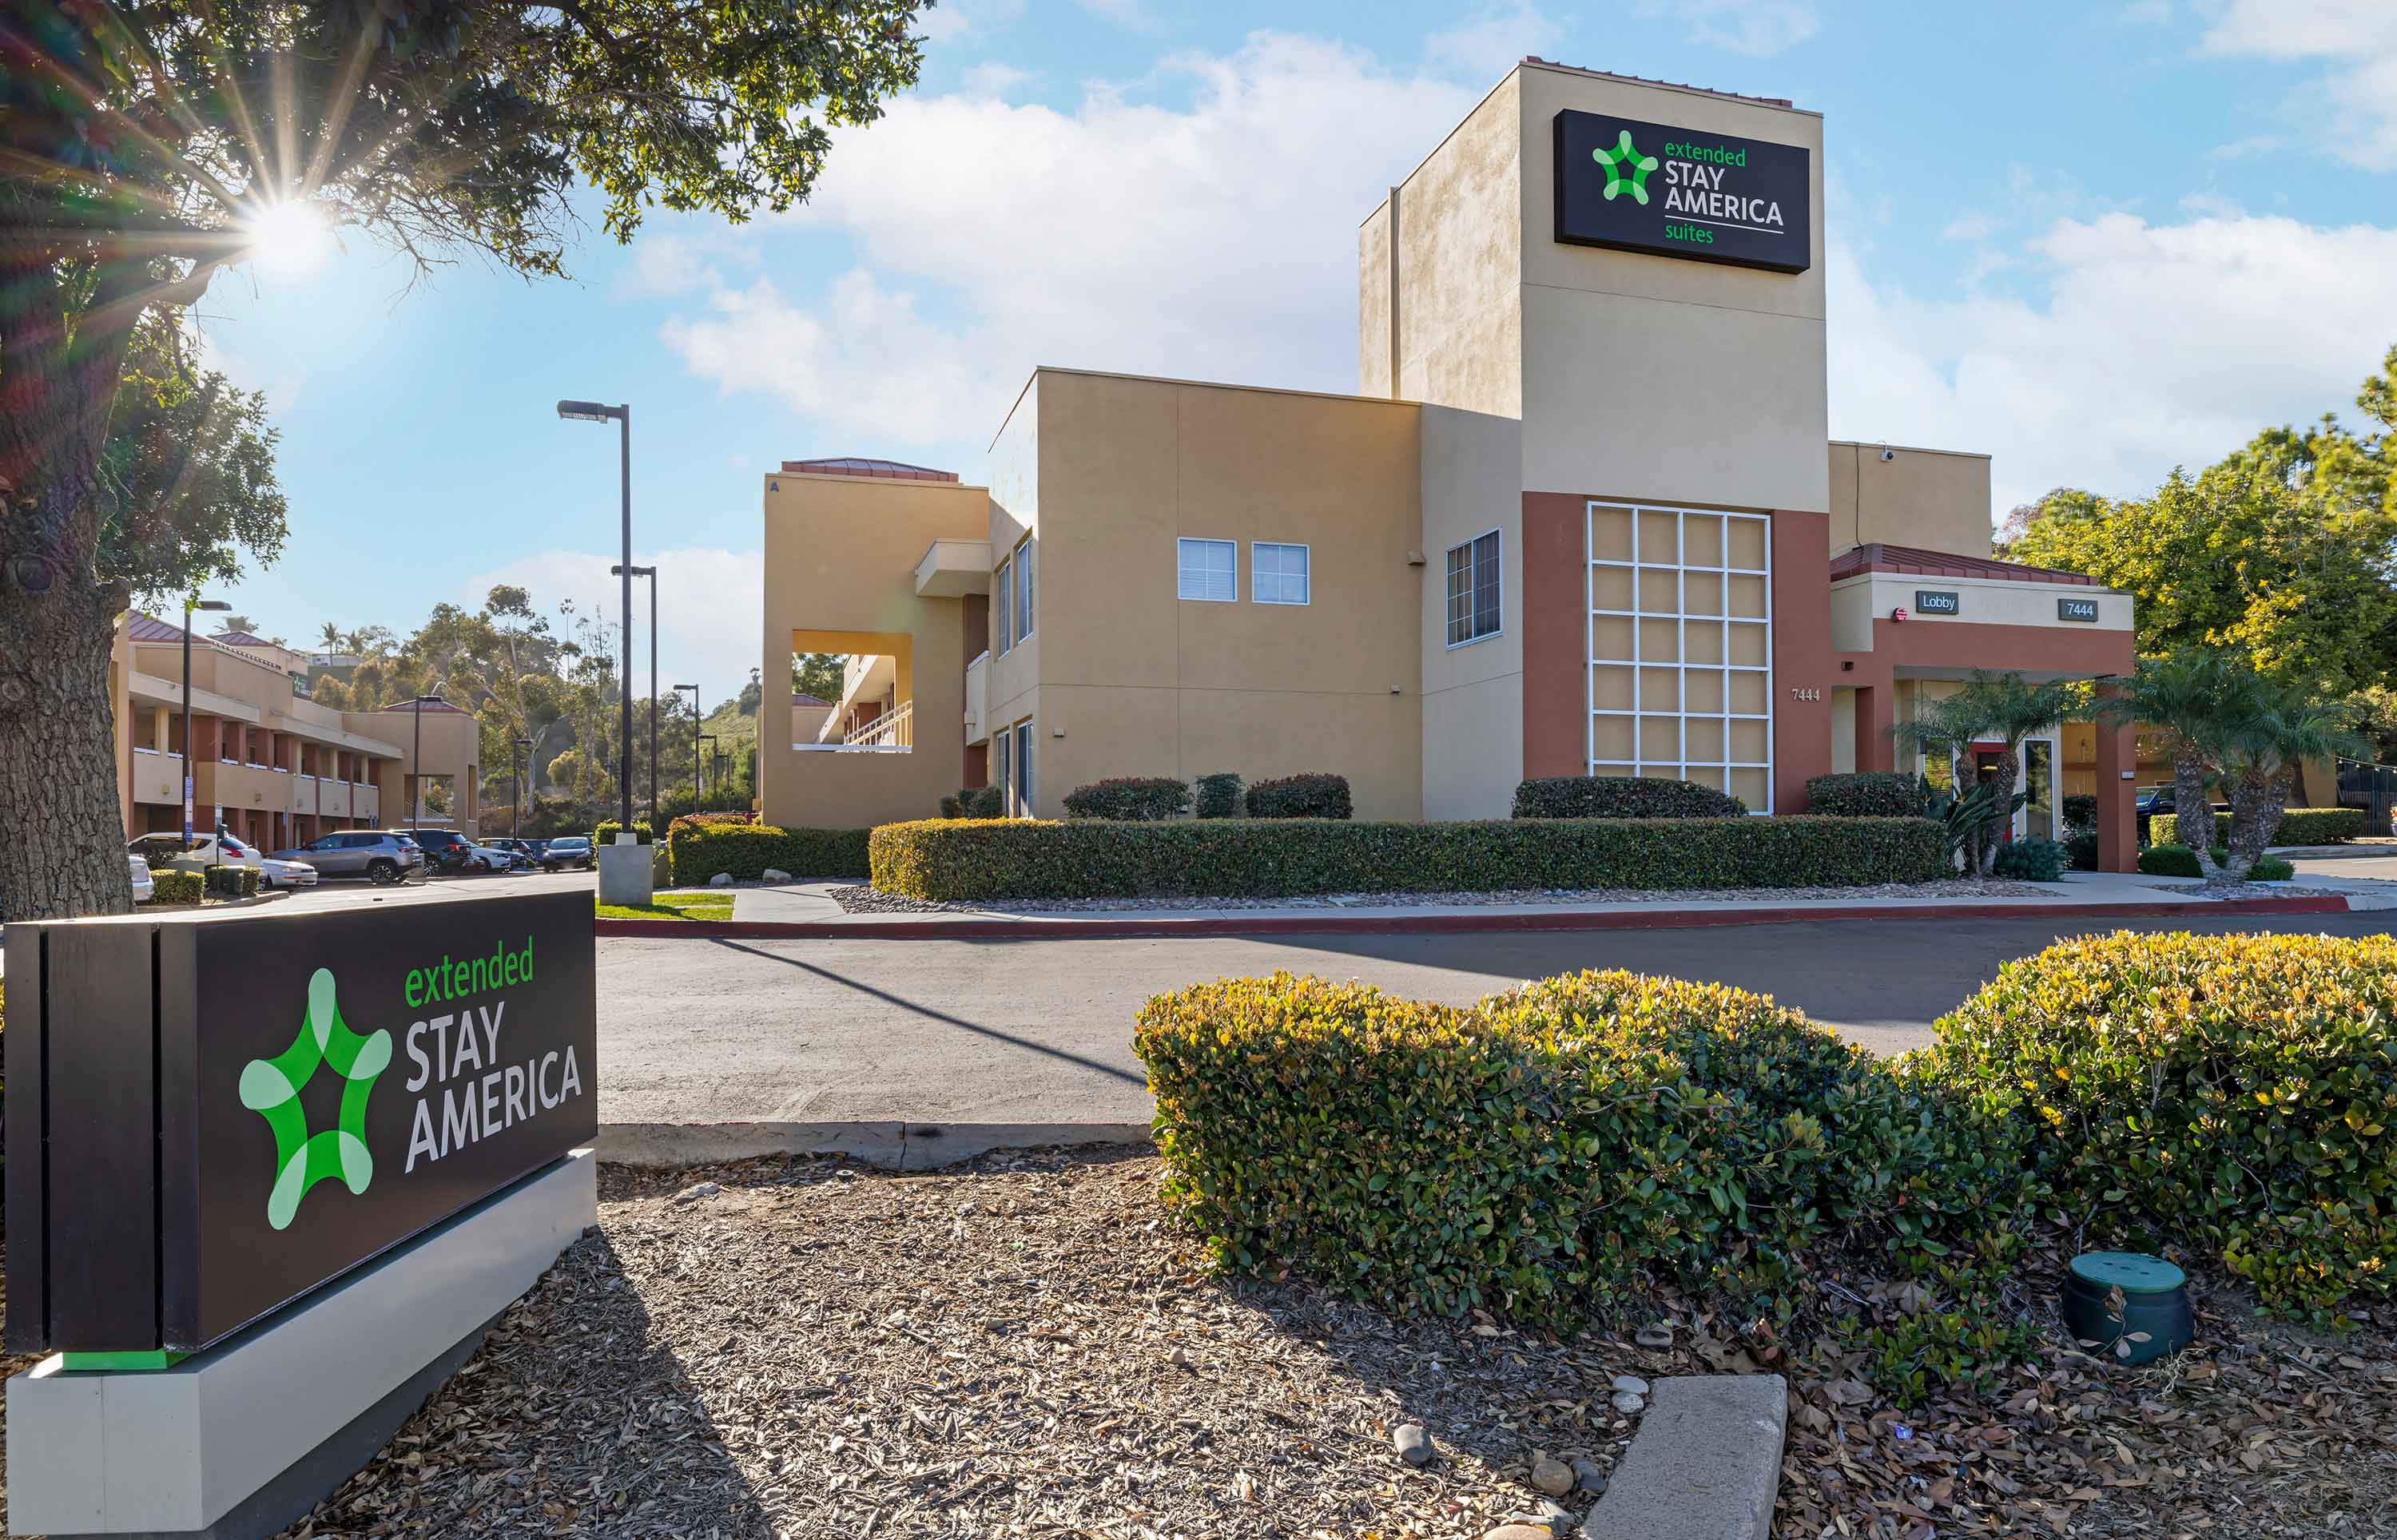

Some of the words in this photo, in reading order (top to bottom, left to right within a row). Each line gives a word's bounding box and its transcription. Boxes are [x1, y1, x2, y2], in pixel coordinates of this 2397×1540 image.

[1664, 141, 1746, 167] extended
[1665, 160, 1725, 190] STAY
[1664, 187, 1784, 226] AMERICA
[1665, 223, 1714, 244] suites
[1923, 594, 1956, 611] Lobby
[2066, 603, 2093, 616] 7444
[1791, 689, 1821, 701] 7444
[404, 935, 534, 1008] extended
[406, 1001, 505, 1093] STAY
[404, 1045, 582, 1174] AMERICA
